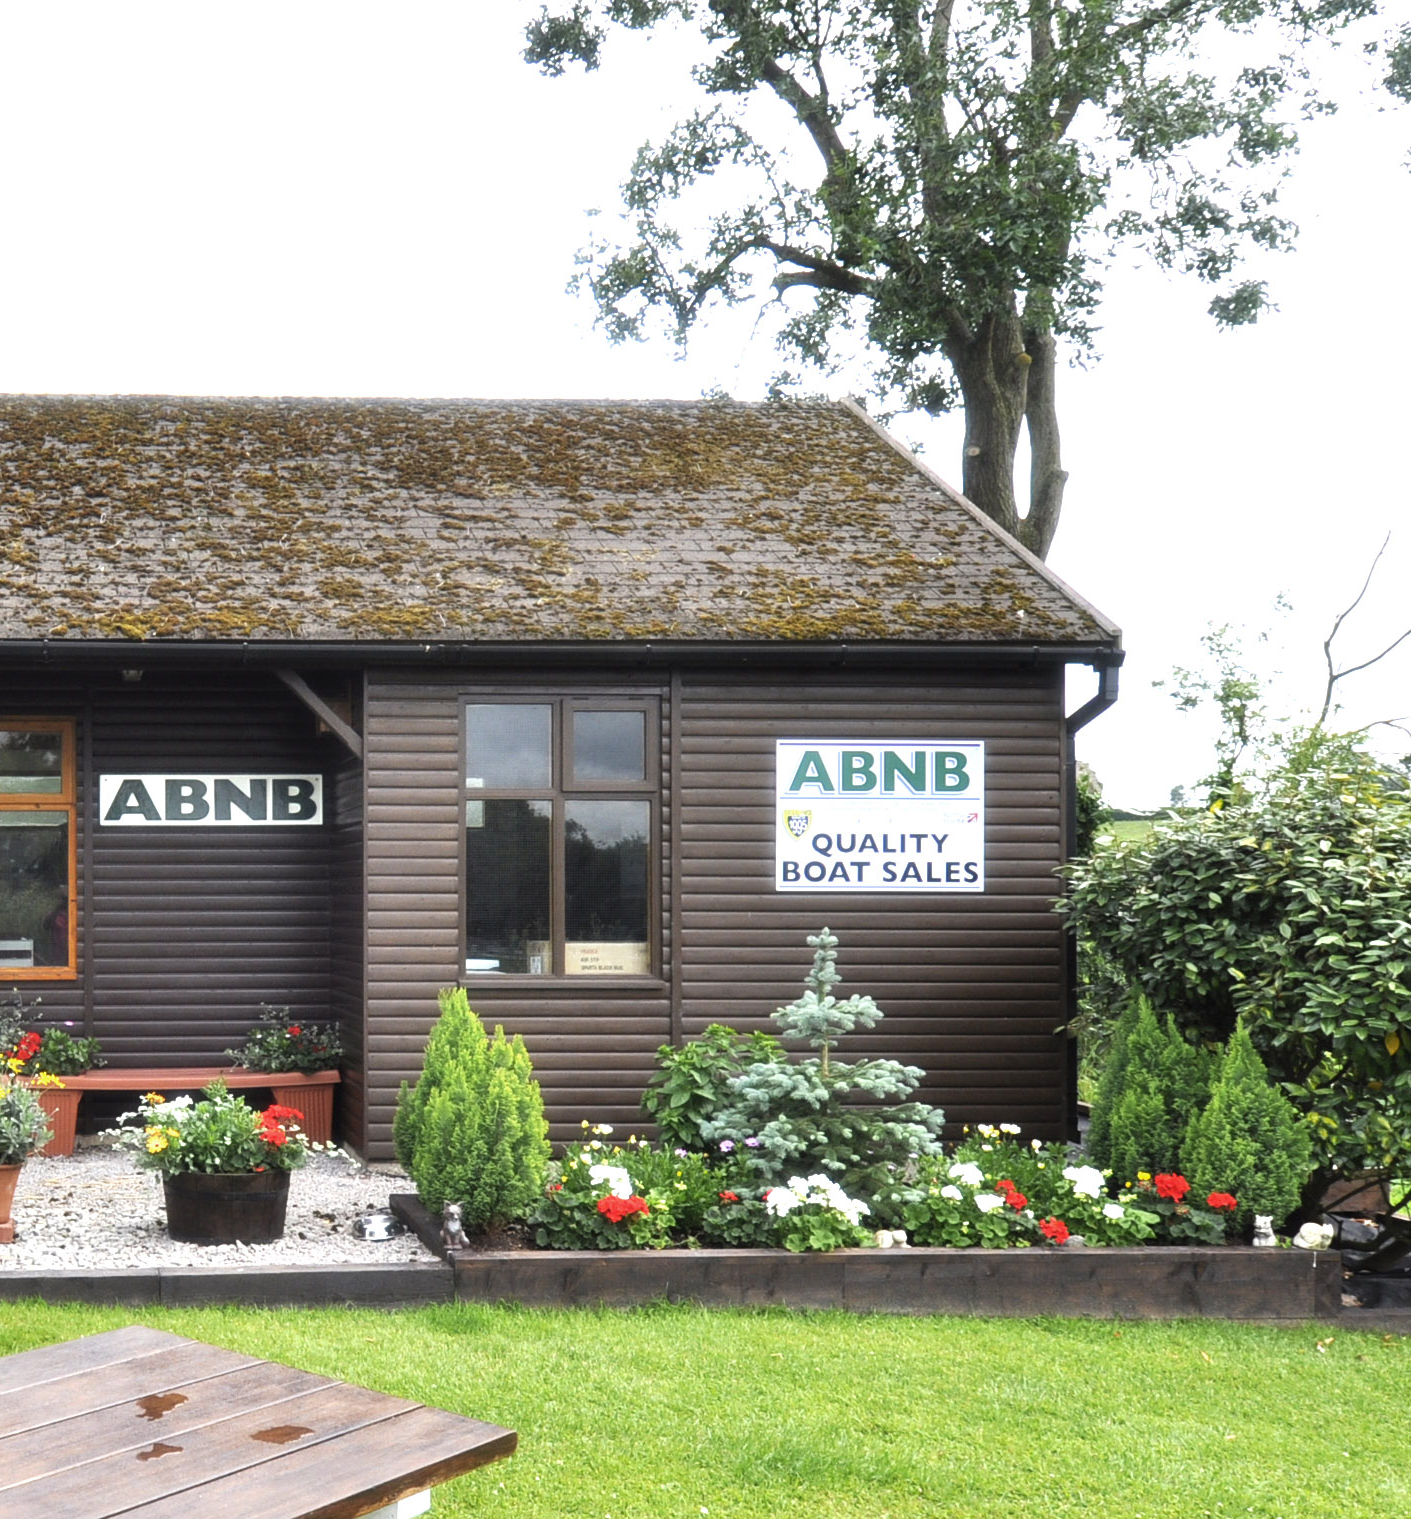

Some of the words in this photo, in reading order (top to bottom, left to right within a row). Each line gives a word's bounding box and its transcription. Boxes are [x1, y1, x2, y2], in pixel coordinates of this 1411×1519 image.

[786, 750, 970, 794] ABNB
[103, 778, 318, 821] ABNB
[811, 833, 950, 857] QUALITY
[782, 861, 871, 882] BOAT
[882, 861, 979, 883] SALES
